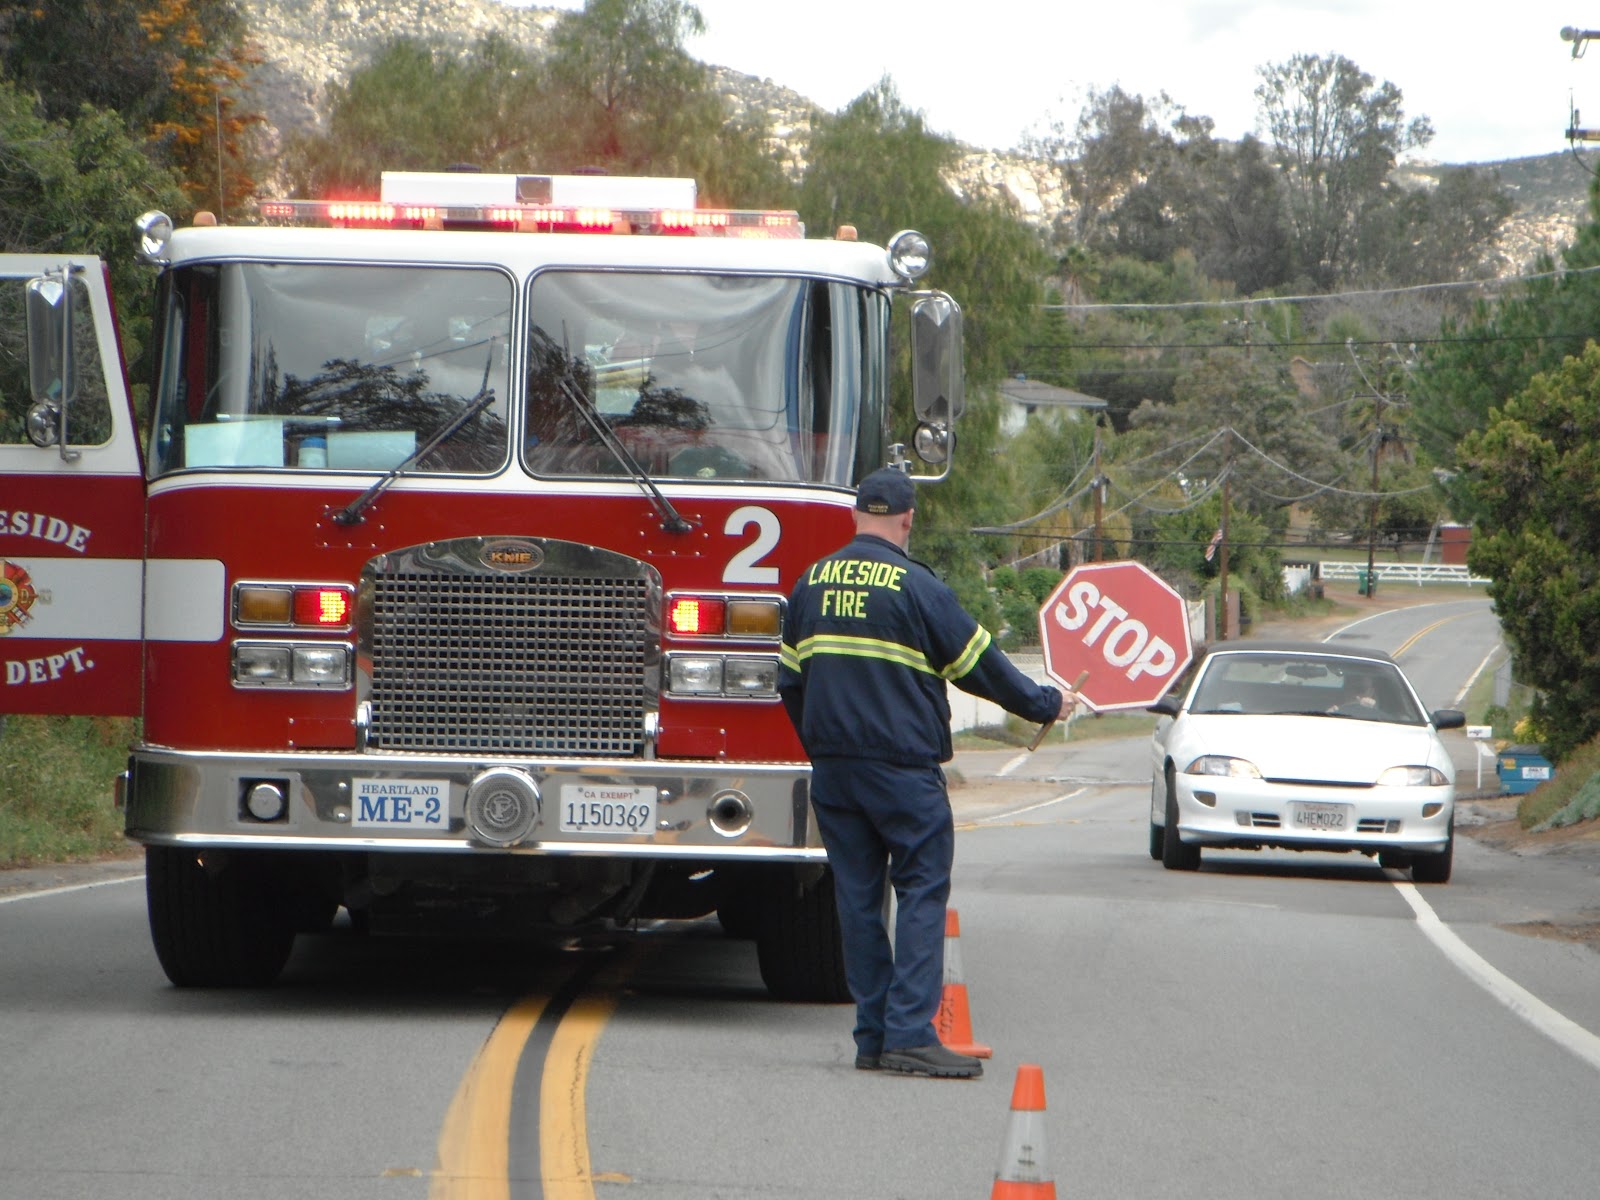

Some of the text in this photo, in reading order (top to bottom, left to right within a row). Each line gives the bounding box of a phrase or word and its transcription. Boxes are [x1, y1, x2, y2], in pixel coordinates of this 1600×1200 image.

[722, 505, 781, 584] 2
[808, 560, 907, 592] LAKESIDE
[821, 589, 870, 618] FIRE
[1055, 581, 1176, 682] STOP
[5, 647, 94, 685] DEPT.
[361, 784, 439, 796] HEARTLAND
[584, 791, 634, 800] CA EXEMPT
[358, 795, 441, 824] ME-2
[566, 802, 650, 828] 1150369
